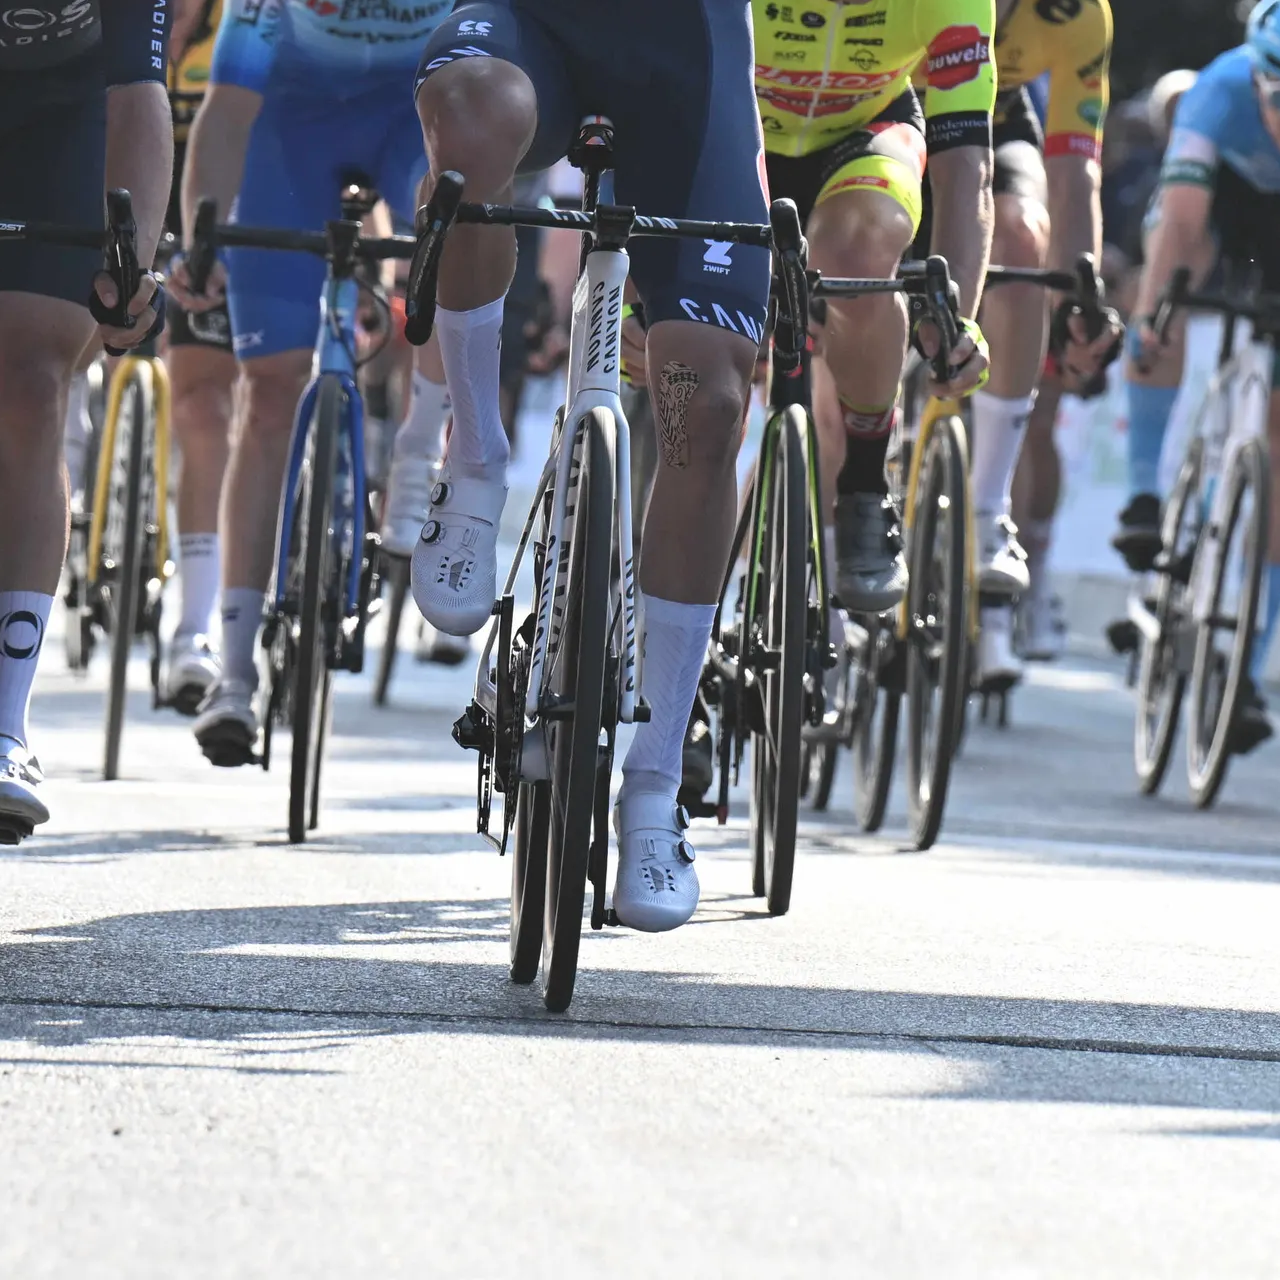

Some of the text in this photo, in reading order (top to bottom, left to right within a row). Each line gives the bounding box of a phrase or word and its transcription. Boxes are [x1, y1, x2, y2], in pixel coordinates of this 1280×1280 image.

[703, 264, 731, 275] ZWIFT
[586, 281, 605, 373] CANYON
[603, 285, 621, 374] CANYON
